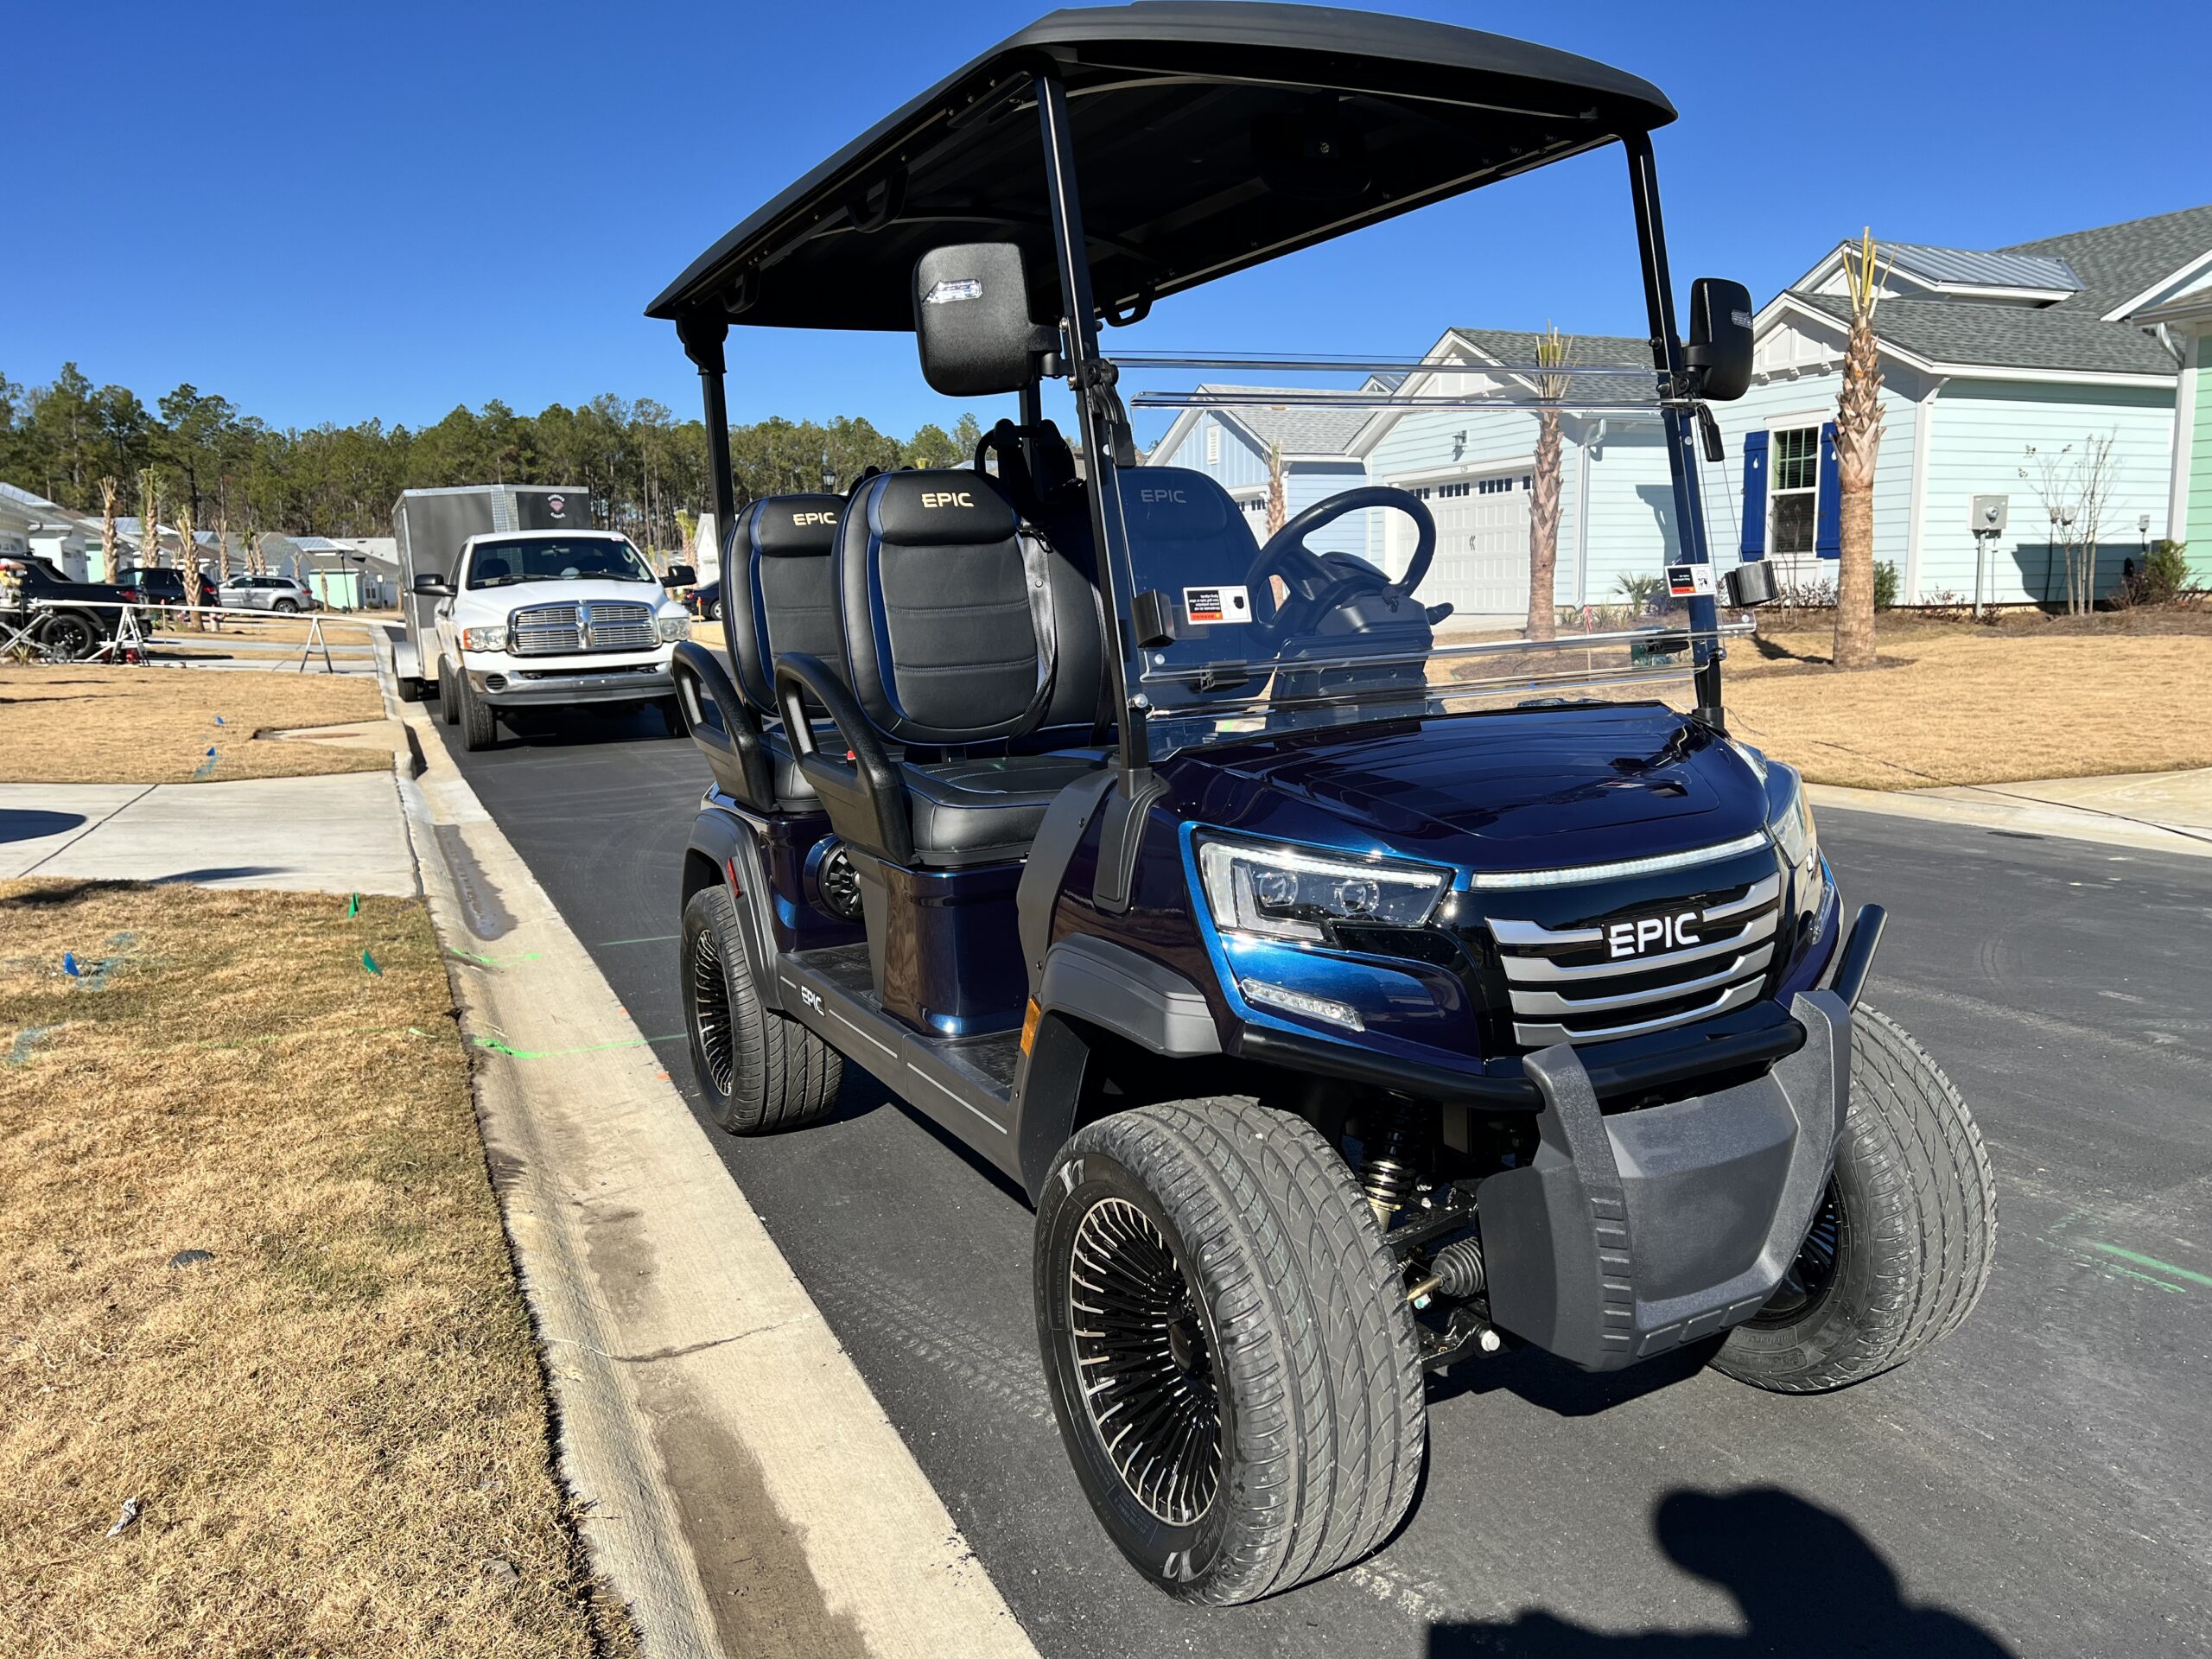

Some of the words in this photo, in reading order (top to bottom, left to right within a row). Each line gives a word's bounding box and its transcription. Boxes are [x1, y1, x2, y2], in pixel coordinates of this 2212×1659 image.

[921, 492, 975, 508] EPIC
[1141, 489, 1187, 504] EPIC
[792, 512, 837, 526] EPIC
[1608, 912, 1701, 958] EPIC
[800, 985, 825, 1016] EPIC
